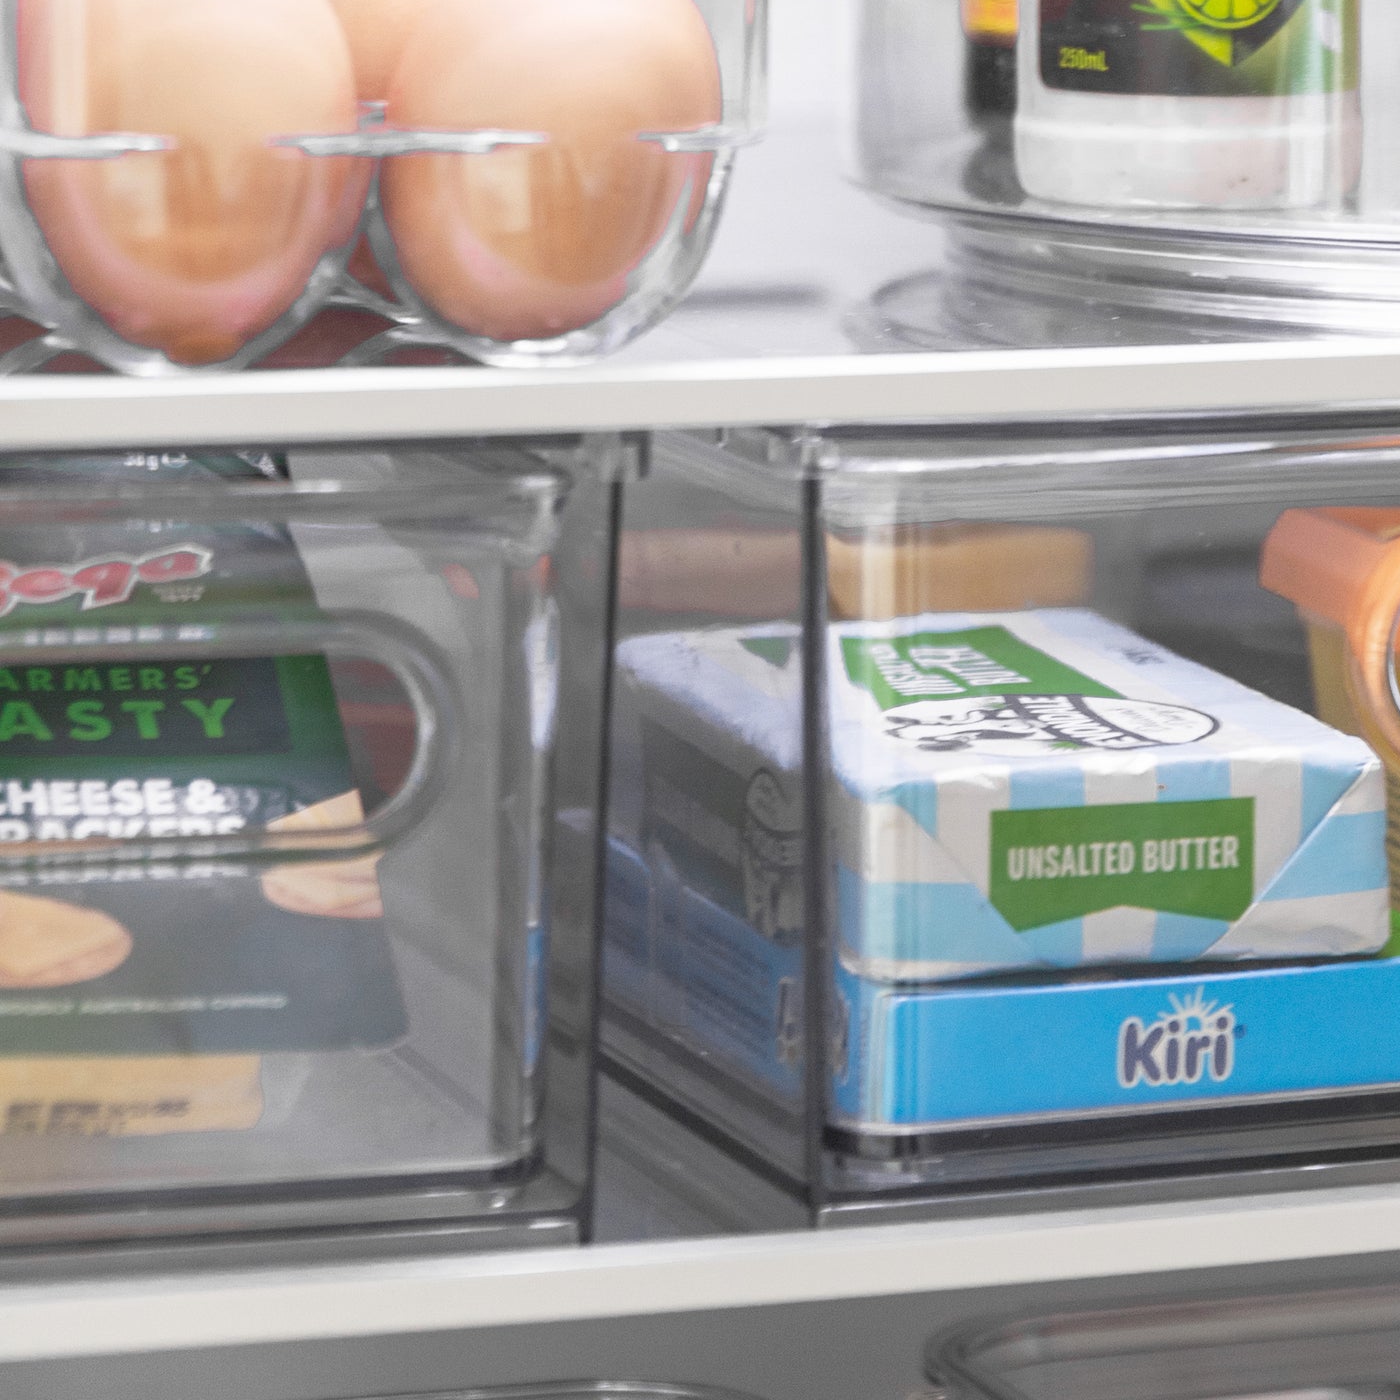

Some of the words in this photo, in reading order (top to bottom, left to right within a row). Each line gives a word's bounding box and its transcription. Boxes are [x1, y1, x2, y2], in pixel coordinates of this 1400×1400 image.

[1059, 47, 1109, 72] 250mL
[0, 664, 212, 692] ARMERS'
[0, 697, 236, 742] ASTY
[1018, 695, 1144, 747] EVONDALE
[1007, 839, 1136, 881] UNSALTED
[1141, 833, 1241, 875] BUTTER
[1116, 1013, 1236, 1089] Kiri
